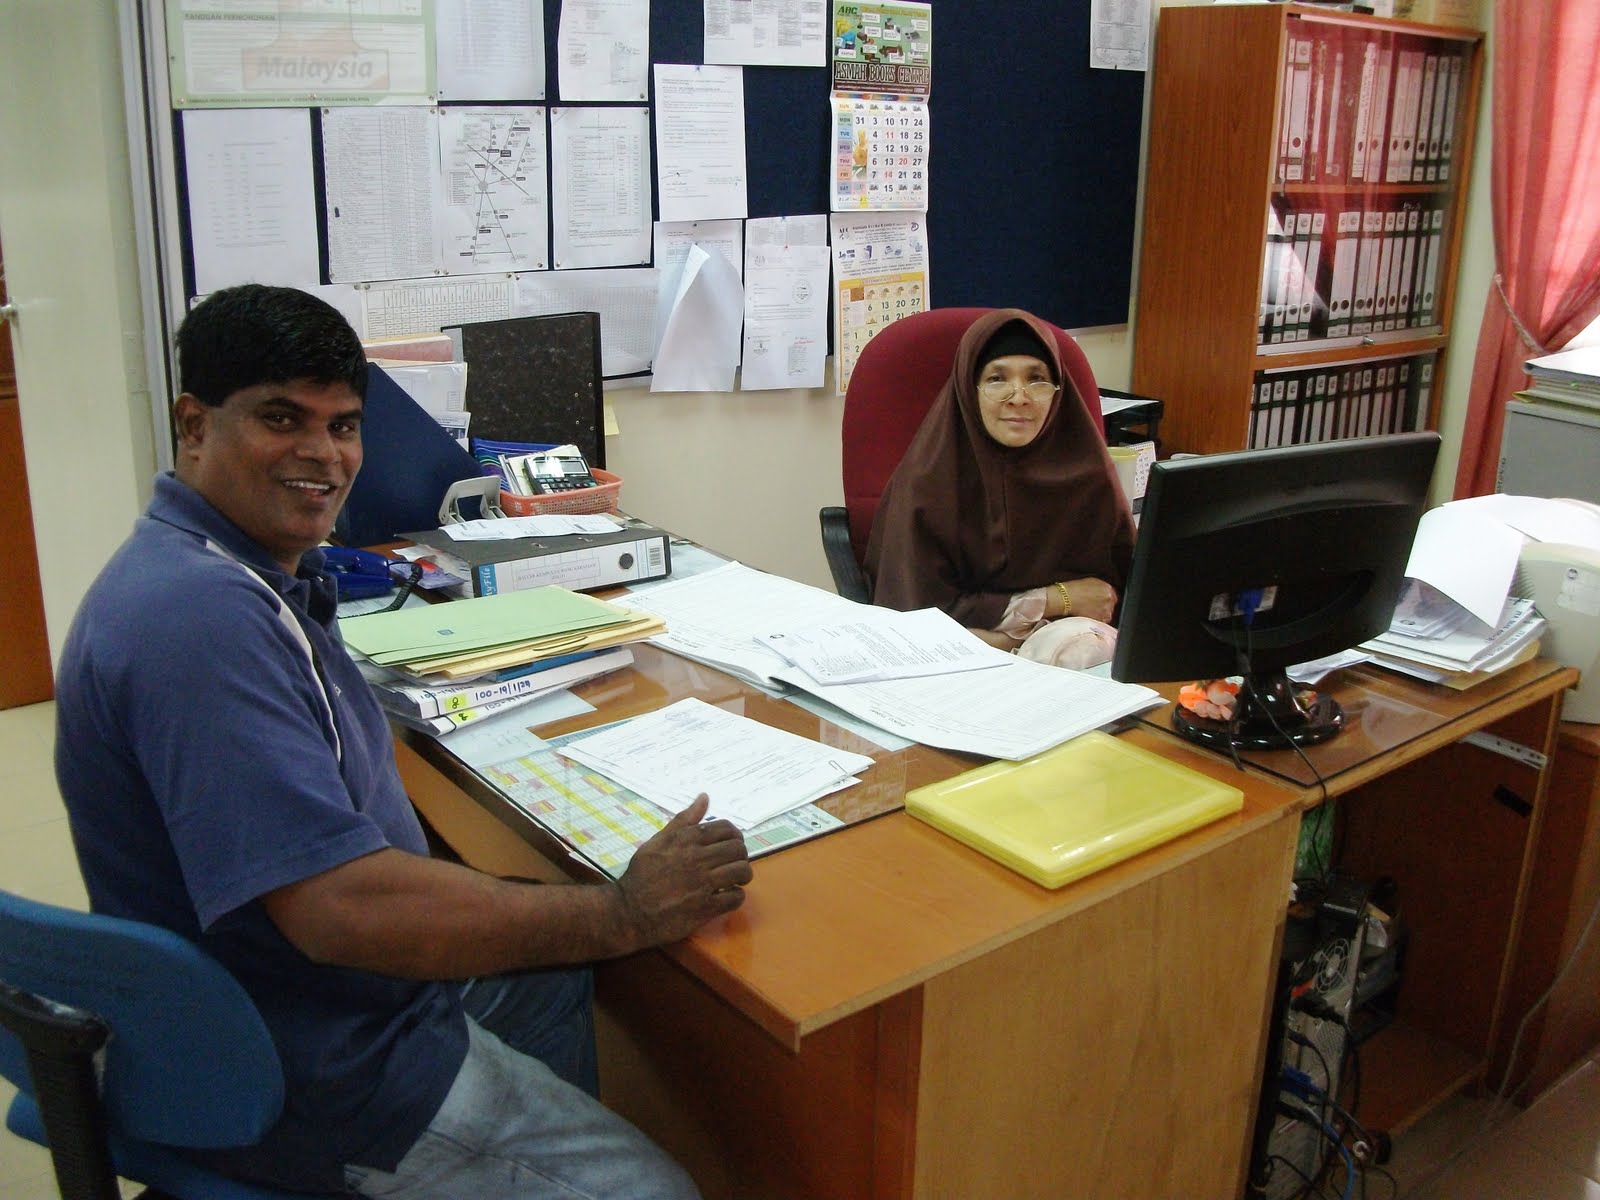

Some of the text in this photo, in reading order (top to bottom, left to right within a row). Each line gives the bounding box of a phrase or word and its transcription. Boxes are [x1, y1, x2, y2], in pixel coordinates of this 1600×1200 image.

[837, 5, 858, 15] ABC
[257, 51, 373, 84] Malaysia
[835, 62, 929, 84] ASMAH BOOKS CENTRE
[855, 116, 865, 125] 31
[872, 117, 878, 125] 3
[885, 117, 895, 126] 10
[900, 118, 909, 126] 17
[914, 118, 923, 127] 24
[872, 130, 878, 138] 4
[885, 131, 894, 139] 11
[914, 132, 923, 140] 25
[872, 144, 878, 152] 5
[900, 145, 909, 153] 19
[913, 145, 923, 153] 26
[872, 158, 878, 166] 6
[885, 158, 894, 166] 13
[898, 158, 908, 166] 20
[912, 158, 922, 166] 27
[872, 171, 877, 179] 7
[898, 171, 907, 179] 21
[912, 171, 922, 179] 28
[867, 297, 921, 312] 6 13 20 27
[881, 312, 904, 322] 14 21
[868, 330, 873, 338] 8
[855, 345, 860, 353] 2
